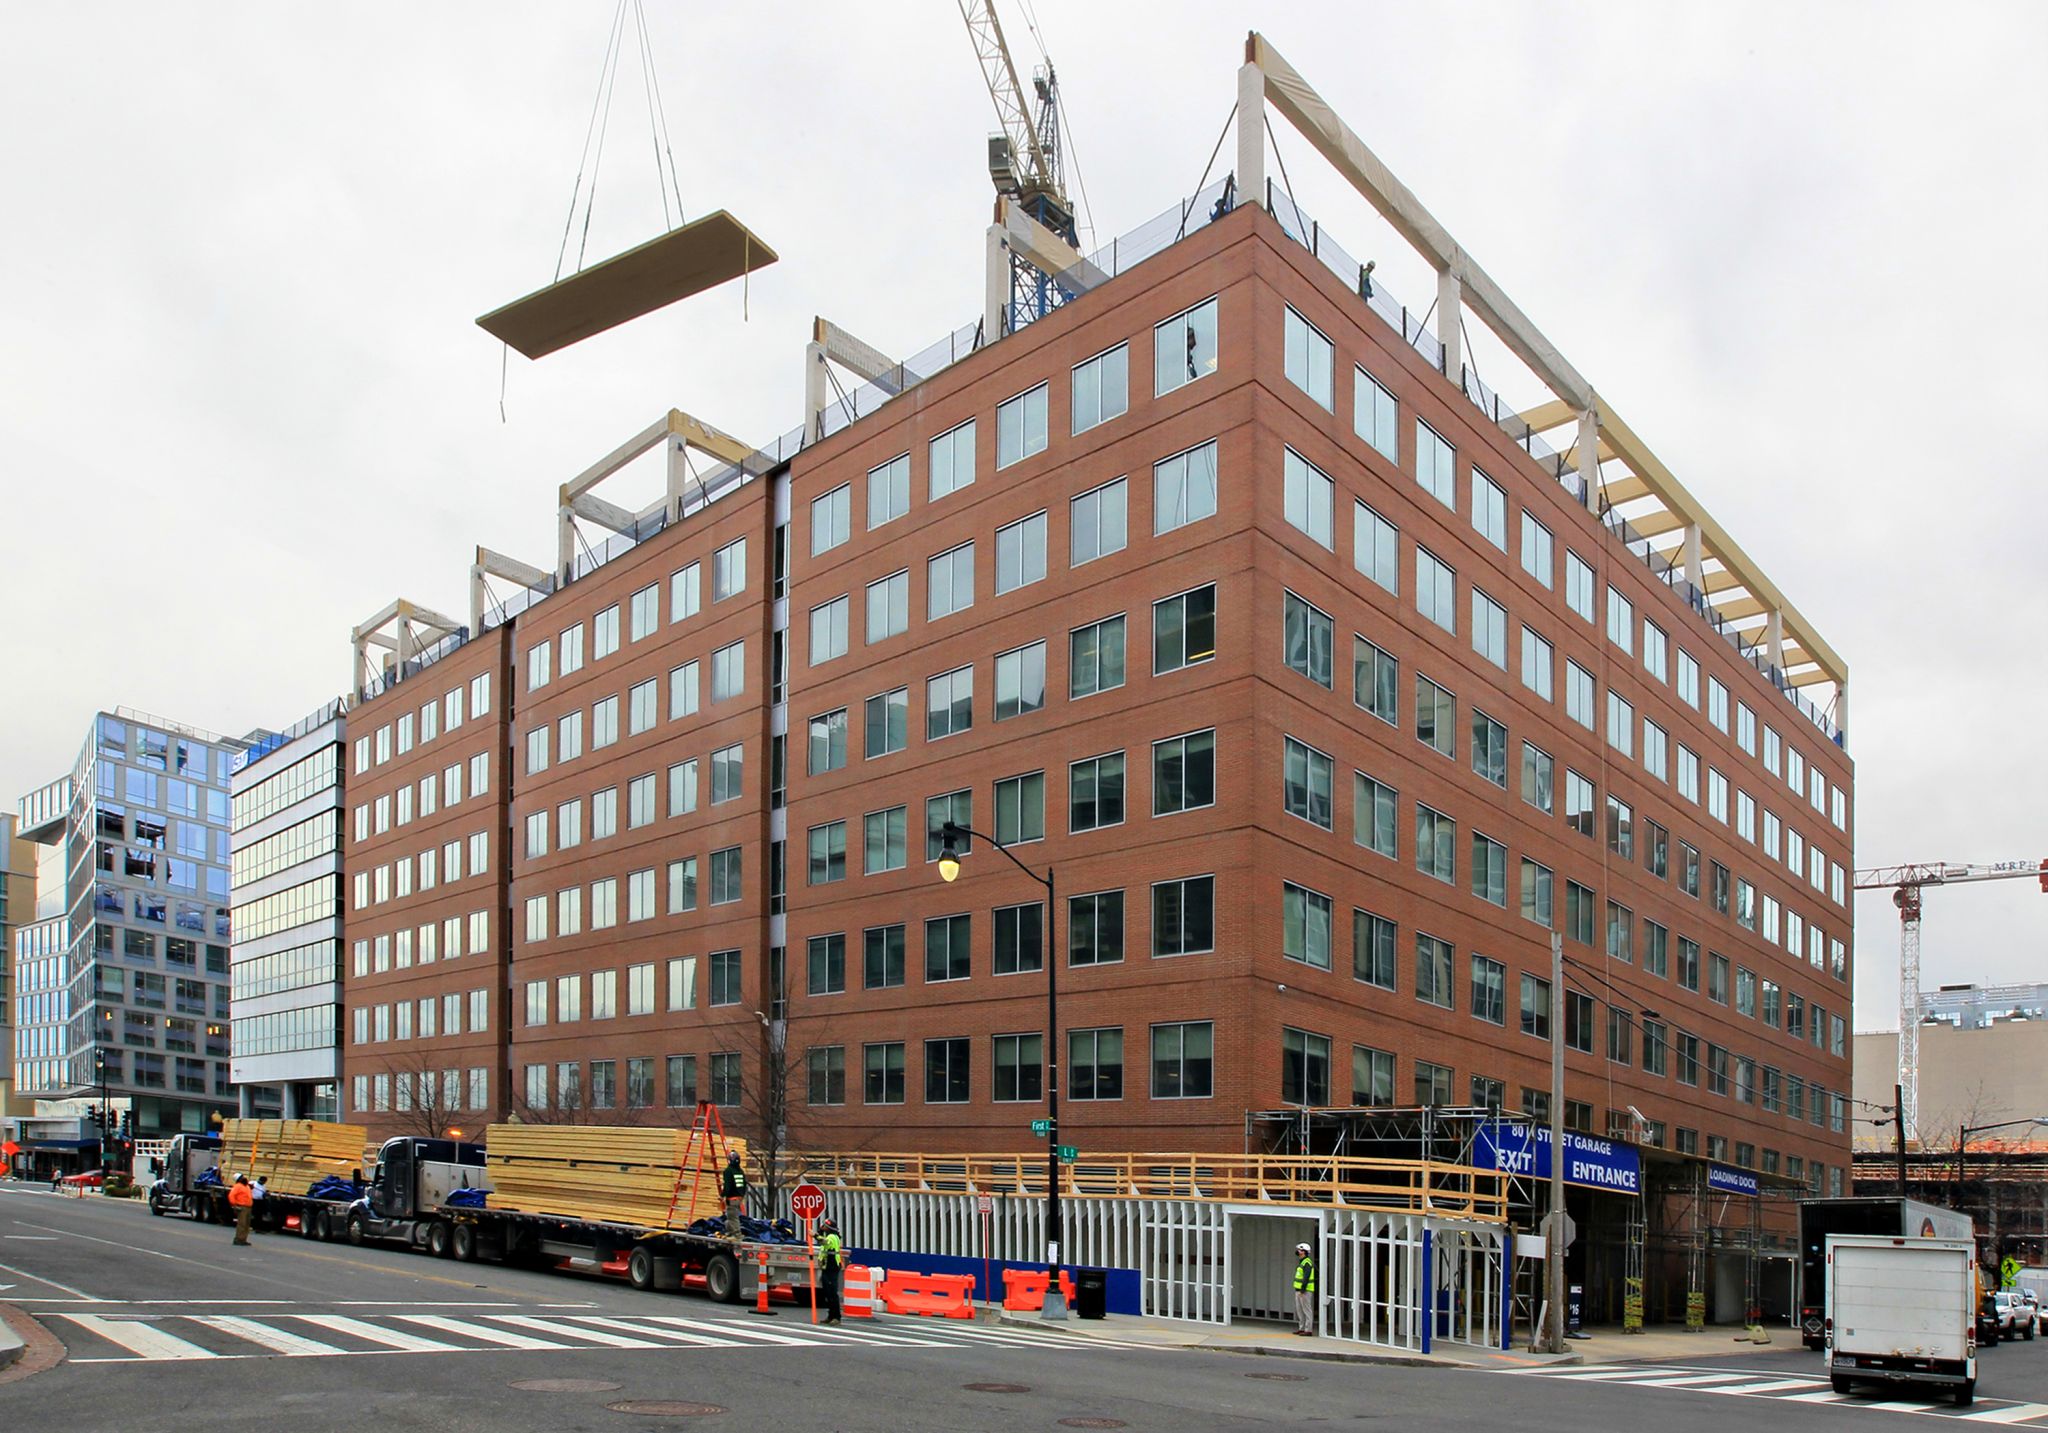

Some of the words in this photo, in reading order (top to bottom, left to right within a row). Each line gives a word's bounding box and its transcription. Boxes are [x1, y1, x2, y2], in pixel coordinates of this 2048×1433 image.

[1511, 1125, 1524, 1137] 80
[1537, 1128, 1573, 1147] STET
[1574, 1136, 1612, 1156] GARAGE
[1498, 1148, 1532, 1171] EXIT
[1573, 1161, 1636, 1188] ENTRANCE
[1710, 1168, 1738, 1185] LOADING
[1739, 1176, 1757, 1189] DOCK
[793, 1195, 823, 1209] STOP
